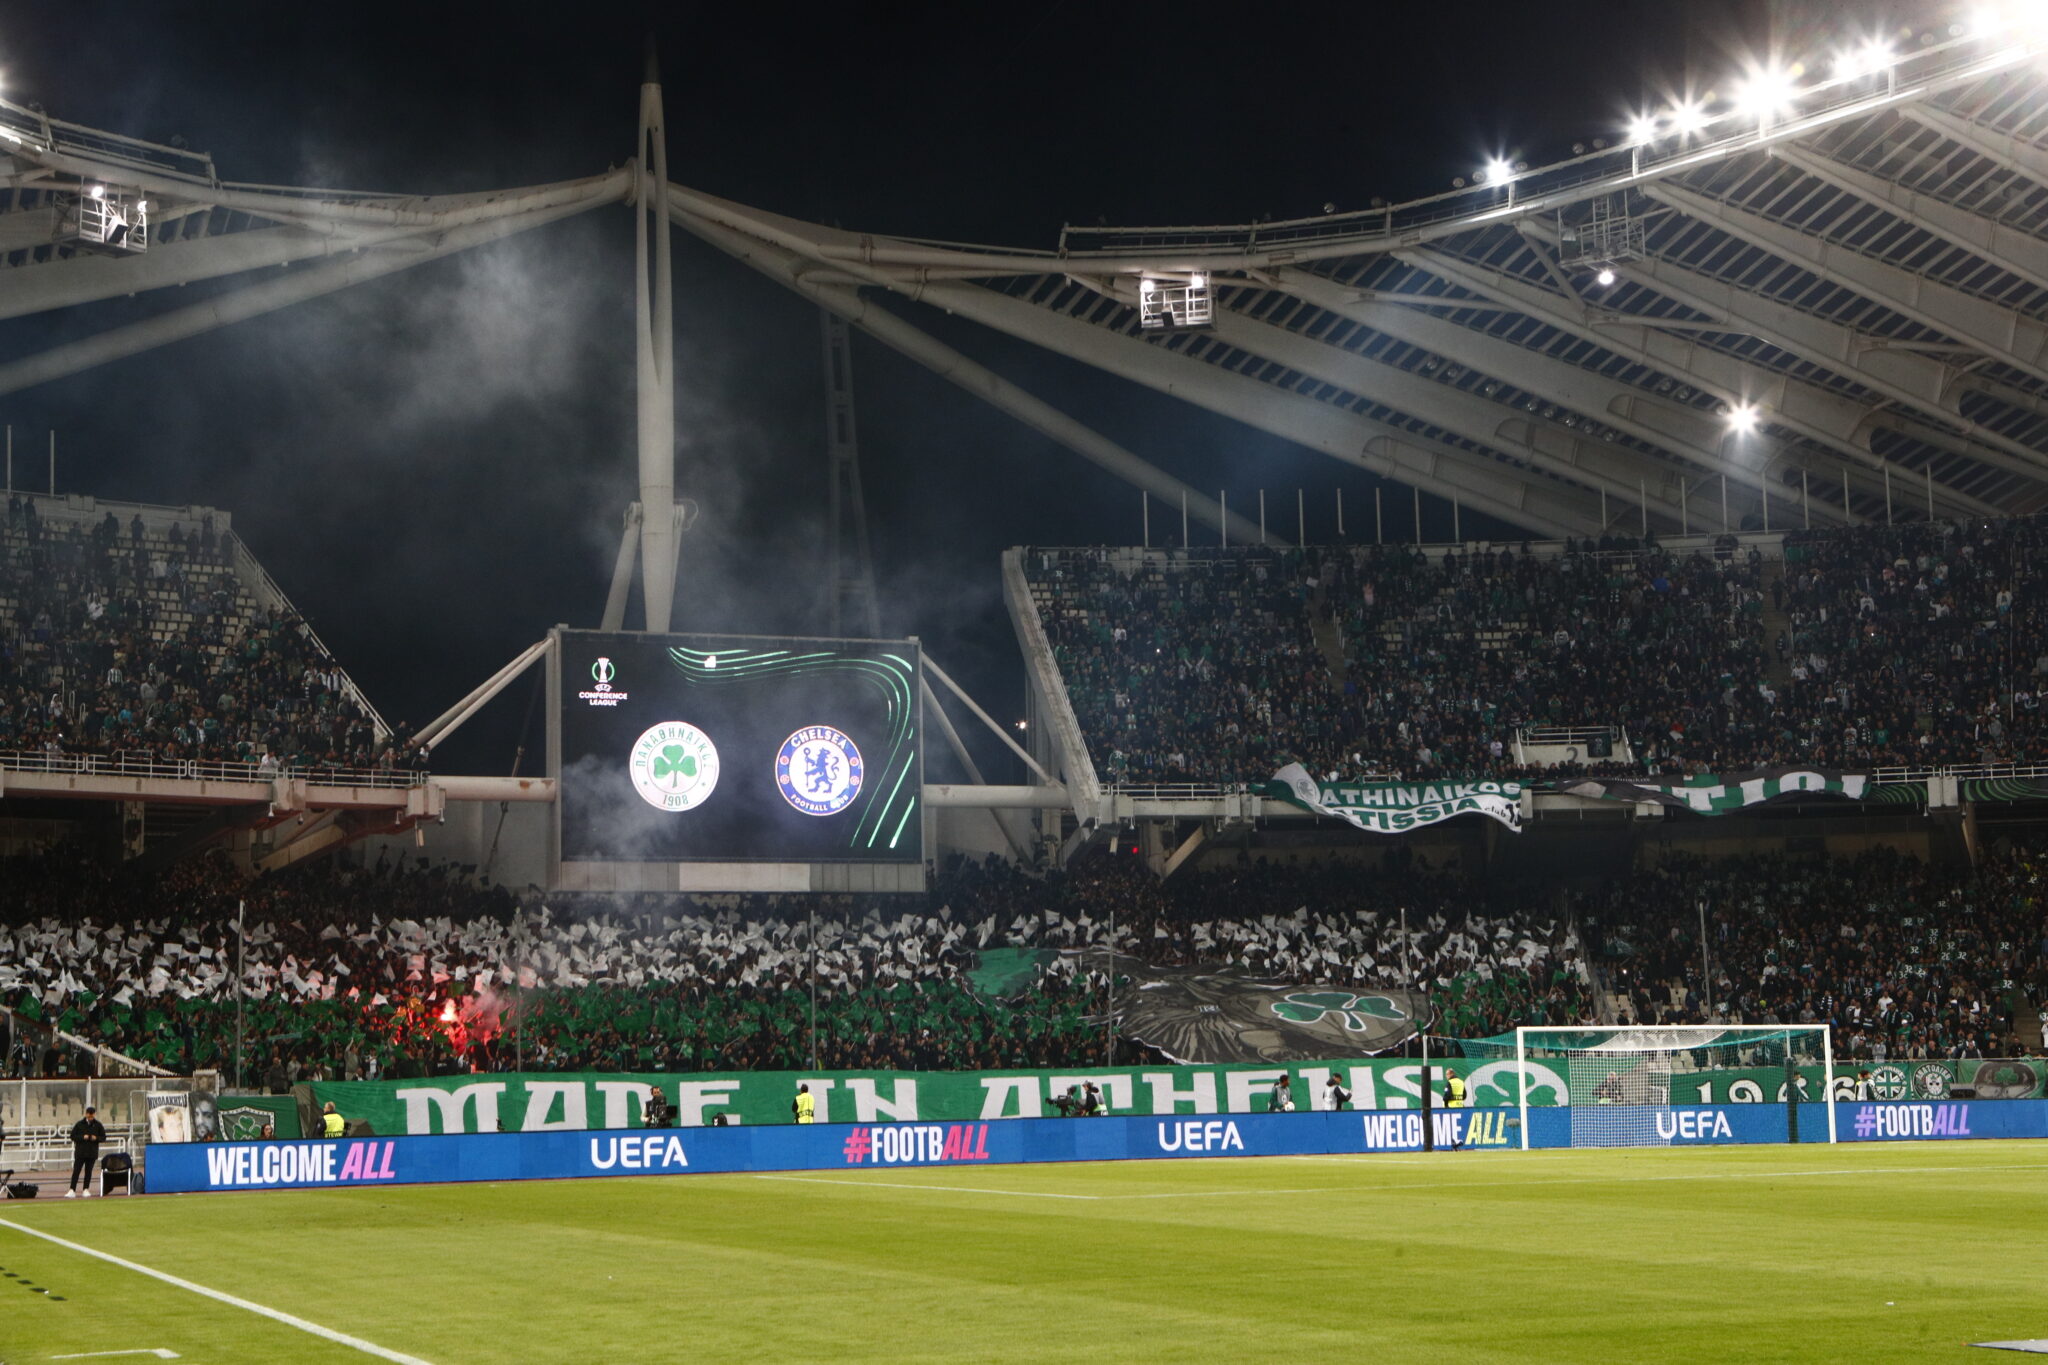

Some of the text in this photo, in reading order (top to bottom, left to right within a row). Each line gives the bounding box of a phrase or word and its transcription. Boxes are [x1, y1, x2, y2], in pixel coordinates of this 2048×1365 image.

[579, 691, 628, 700] CONFERENCE
[589, 698, 618, 706] LEAGUE
[790, 728, 848, 748] CHELSEA
[662, 794, 690, 807] 1908
[790, 794, 829, 812] FOOTBALL
[1319, 781, 1522, 807] ATHINAIKOS
[395, 1065, 1444, 1135] MADE IN ATHENS
[1465, 1111, 1507, 1145] ALL
[1655, 1110, 1733, 1139] UEFA
[1854, 1104, 1971, 1137] #FOOTBALL
[843, 1124, 989, 1164] #FOOTBALL
[1157, 1120, 1244, 1152] UEFA
[207, 1140, 396, 1186] WELCOME ALL
[590, 1135, 689, 1169] UEFA
